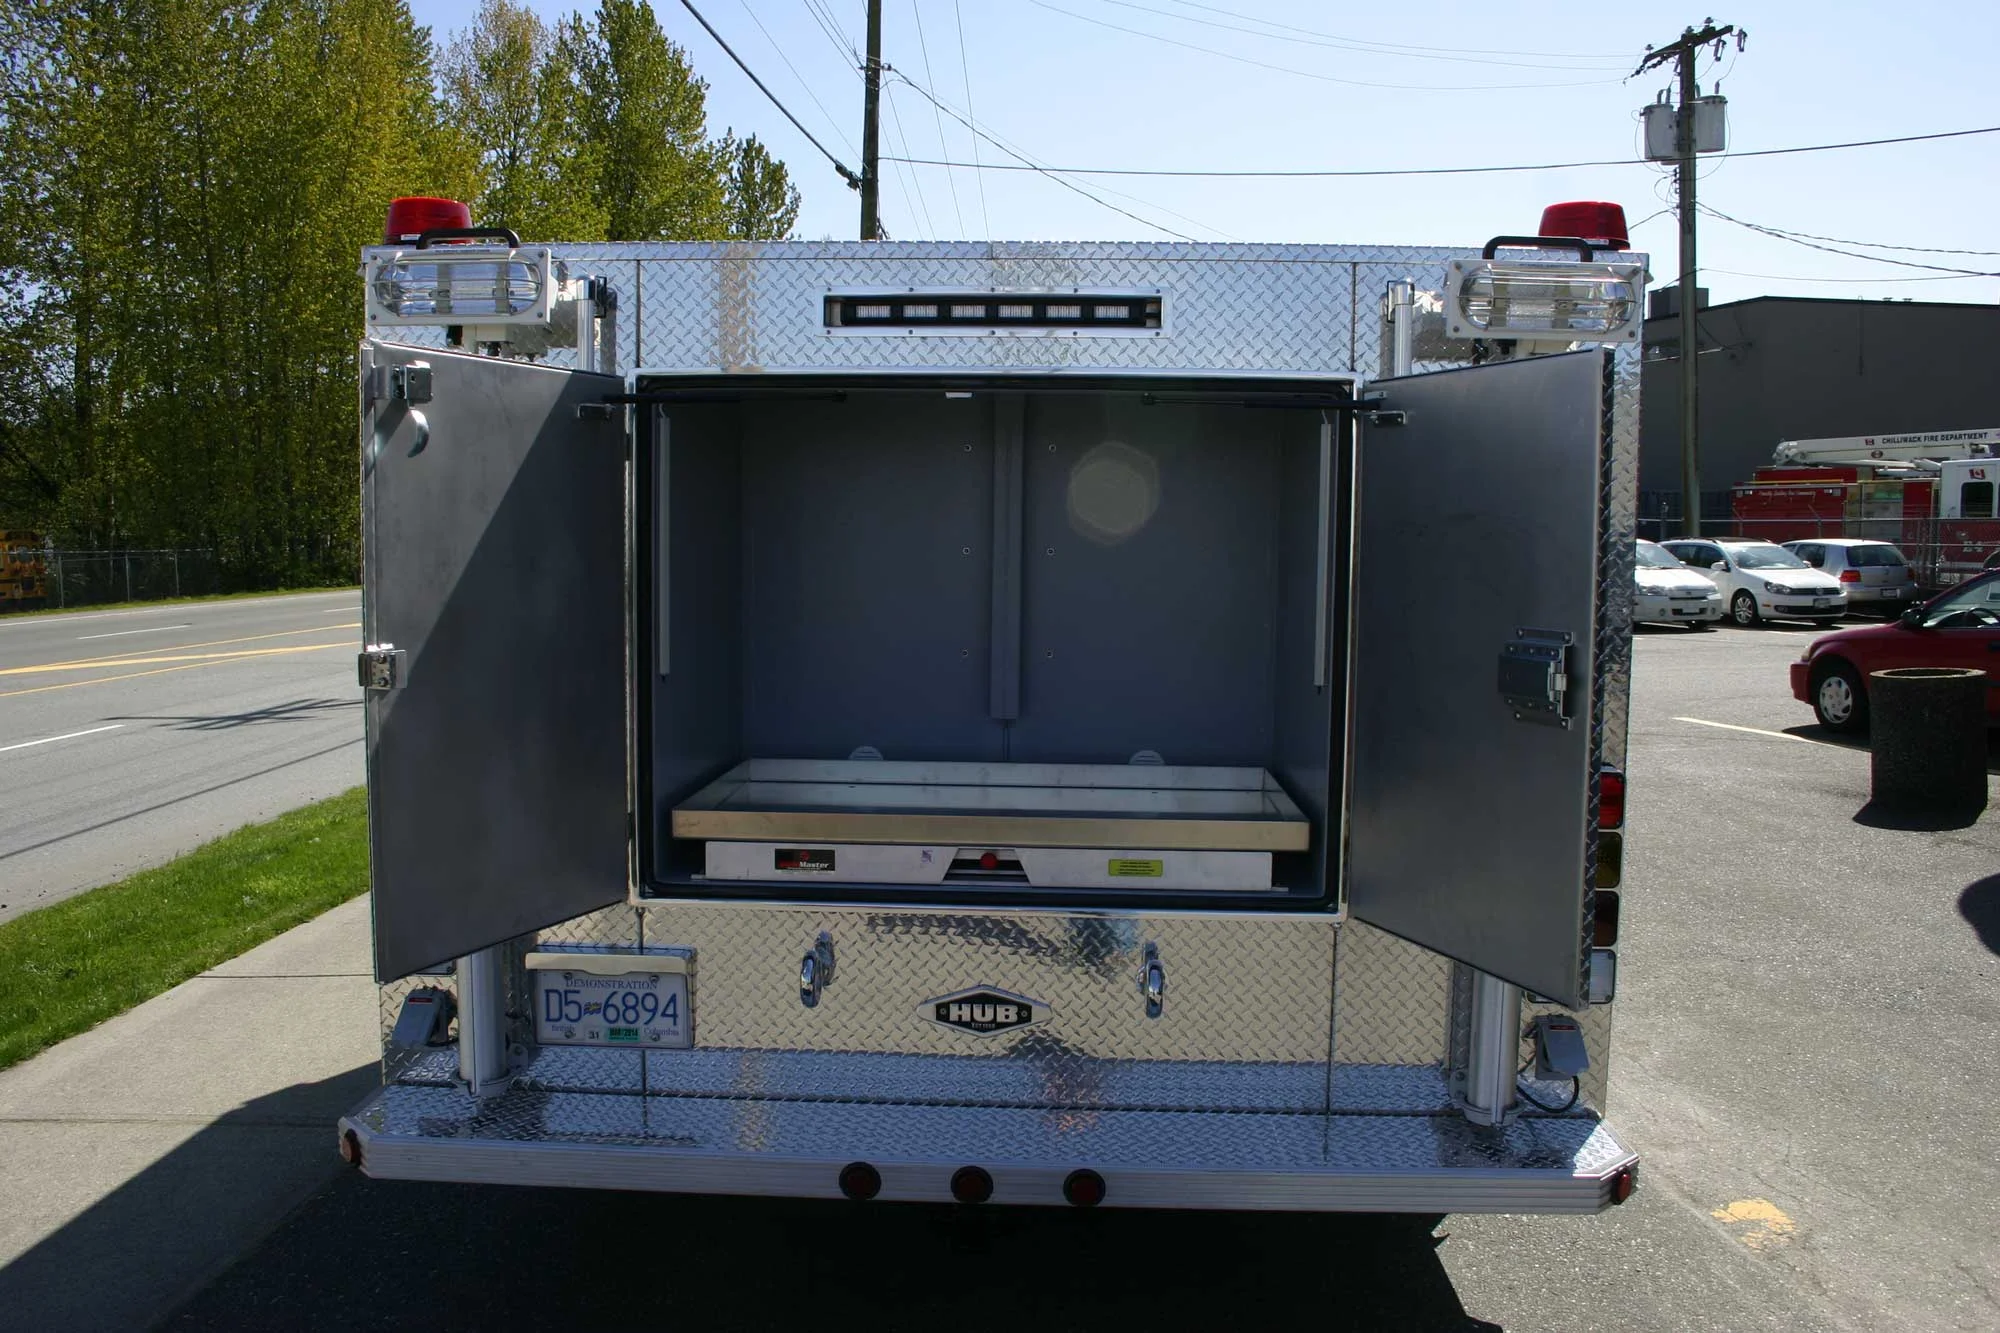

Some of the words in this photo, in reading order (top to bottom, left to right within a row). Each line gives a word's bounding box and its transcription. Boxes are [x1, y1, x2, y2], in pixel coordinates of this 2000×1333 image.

[1882, 436, 1921, 444] CHILLIWACK
[1924, 434, 1938, 442] FIRE
[1940, 432, 1988, 440] DEPARTMENT
[566, 978, 657, 989] DEMONSTRATION
[544, 989, 583, 1022] D5
[602, 991, 679, 1026] 6894
[949, 1003, 1018, 1022] HUB
[588, 1031, 599, 1039] 31
